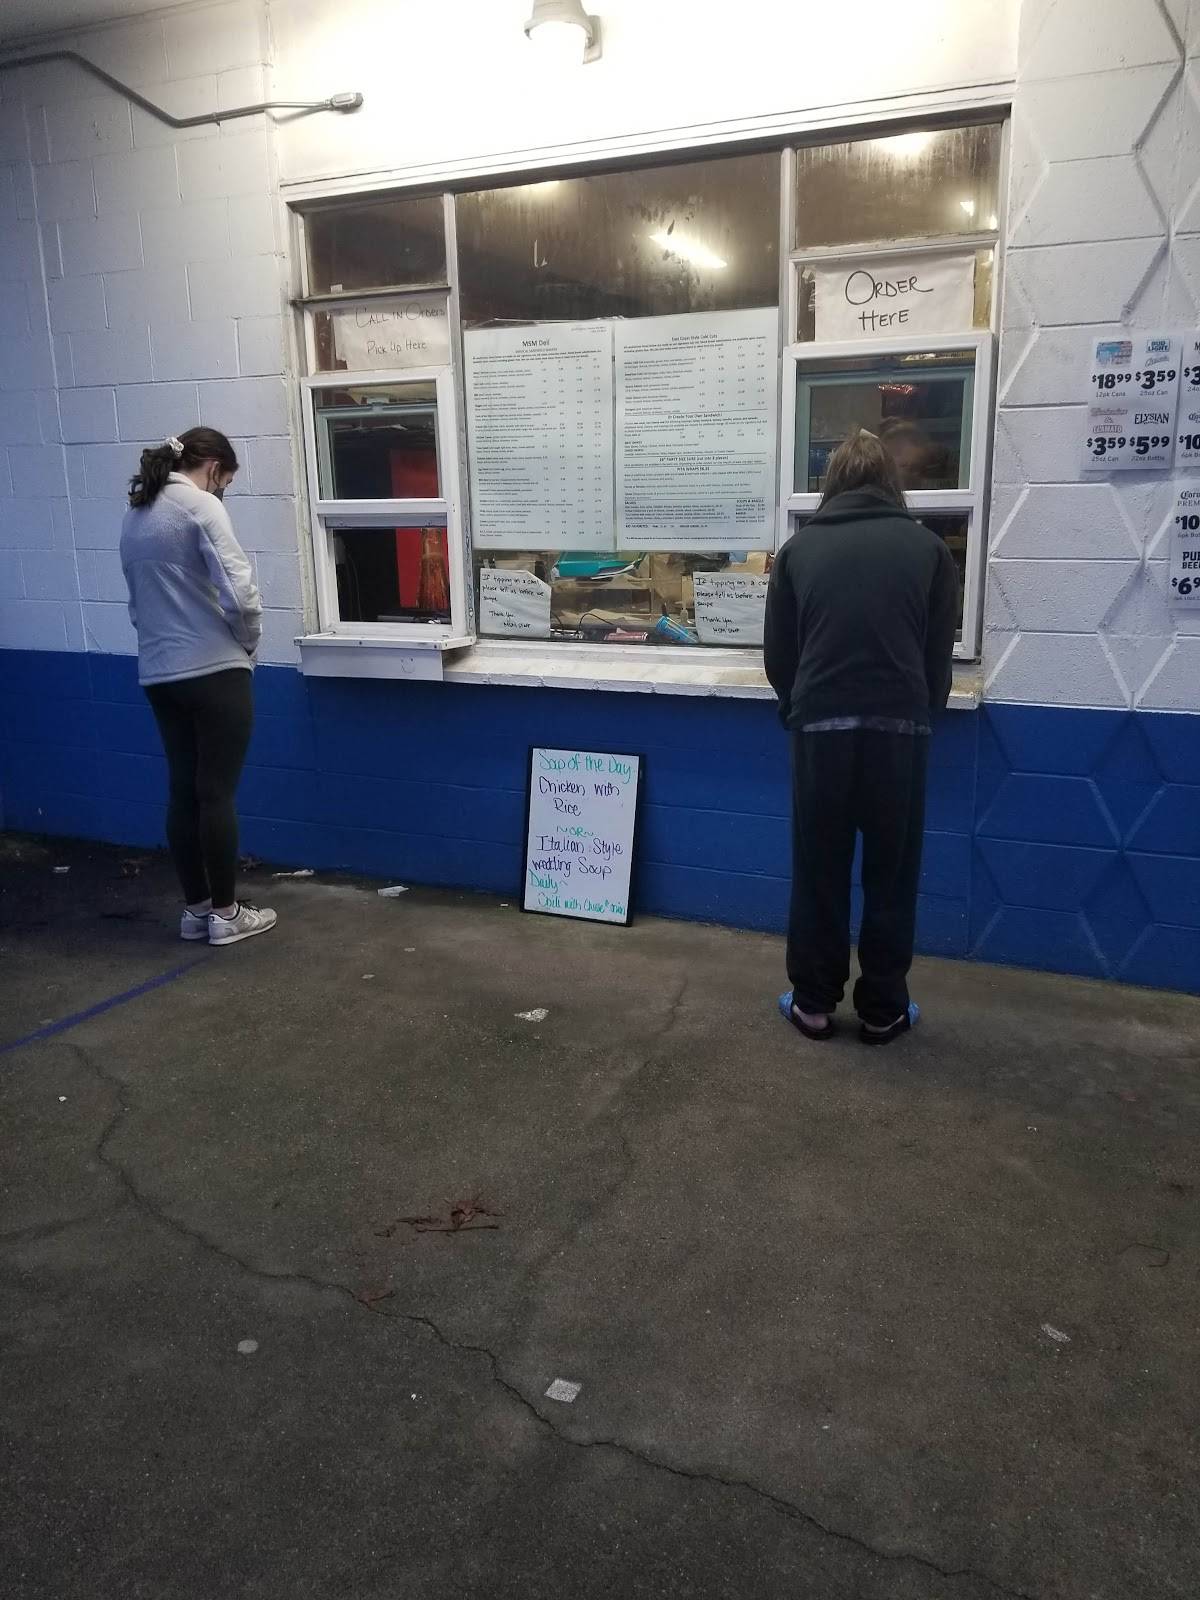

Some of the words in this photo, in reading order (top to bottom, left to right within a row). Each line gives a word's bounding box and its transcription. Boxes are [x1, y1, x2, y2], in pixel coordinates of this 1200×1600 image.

[845, 270, 934, 305] ORDER
[355, 307, 389, 328] CALL
[366, 340, 388, 355] Pick
[1134, 412, 1170, 424] ELYSIAN
[567, 753, 581, 771] of
[585, 754, 605, 772] the
[608, 754, 631, 784] Day
[539, 775, 586, 797] Chicken
[553, 797, 582, 817] Rice
[536, 835, 585, 854] Italian
[592, 837, 624, 861] Style
[577, 856, 612, 881] Soup
